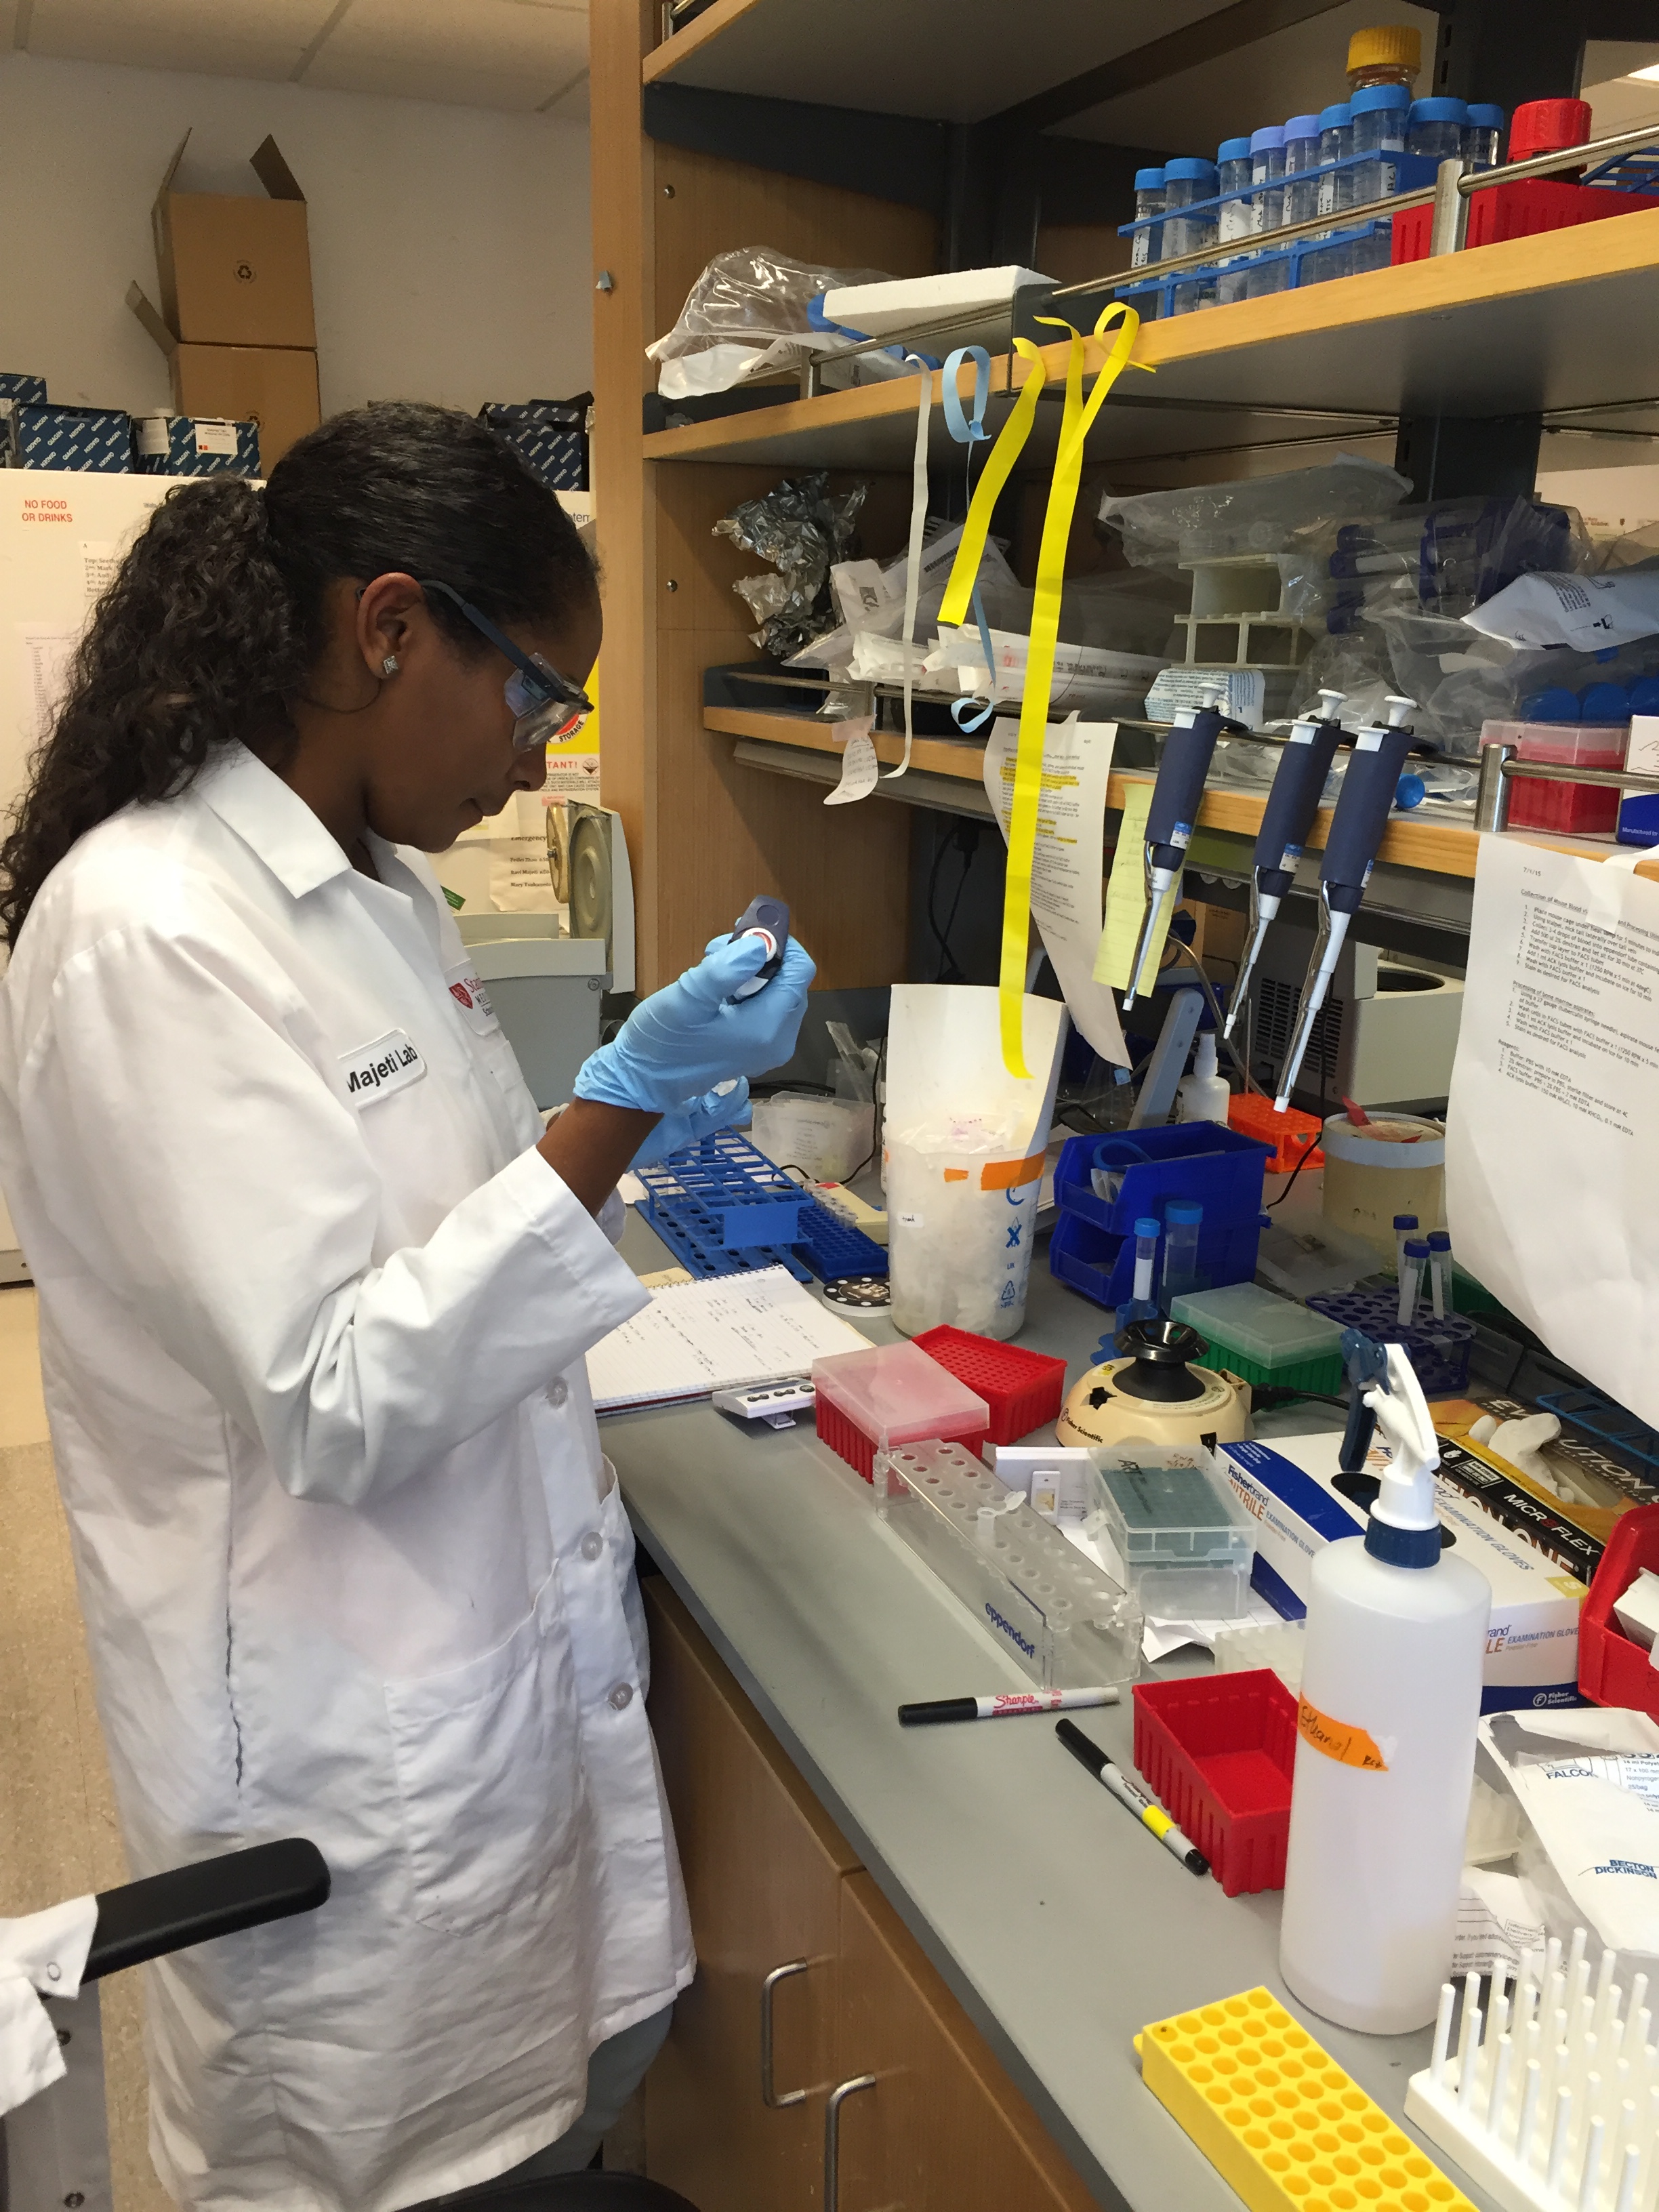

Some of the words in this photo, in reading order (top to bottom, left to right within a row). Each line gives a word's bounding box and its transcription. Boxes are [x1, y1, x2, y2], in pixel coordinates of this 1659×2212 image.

[12, 377, 28, 392] QIAGEN
[32, 415, 48, 431] QIAGEN
[91, 416, 107, 432] QIAGEN
[47, 430, 64, 445] QIAGEN
[105, 430, 121, 446] QIAGEN
[62, 445, 79, 460] QIAGEN
[24, 499, 38, 509] NO
[41, 500, 67, 509] FOOD
[22, 513, 35, 522] OR
[39, 514, 73, 523] DRINKS
[558, 720, 585, 743] STORAGE
[1622, 827, 1652, 836] Manufactured
[346, 1053, 398, 1093] Majeti
[395, 1044, 418, 1067] Lab
[1077, 1426, 1104, 1443] Scientific
[1228, 1465, 1269, 1507] Fisherbrand
[1266, 1511, 1298, 1544] EXAMINATION
[1491, 1540, 1532, 1570] GLOVES
[985, 1603, 1035, 1659] eppendorf
[1507, 1631, 1555, 1644] EXAMINATION
[994, 1694, 1035, 1708] Sharpie
[1548, 1696, 1577, 1704] Scientific
[1302, 1705, 1352, 1761] Ethanol
[1595, 1866, 1658, 1879] DICKINSON
[1610, 1859, 1654, 1872] BECTON
